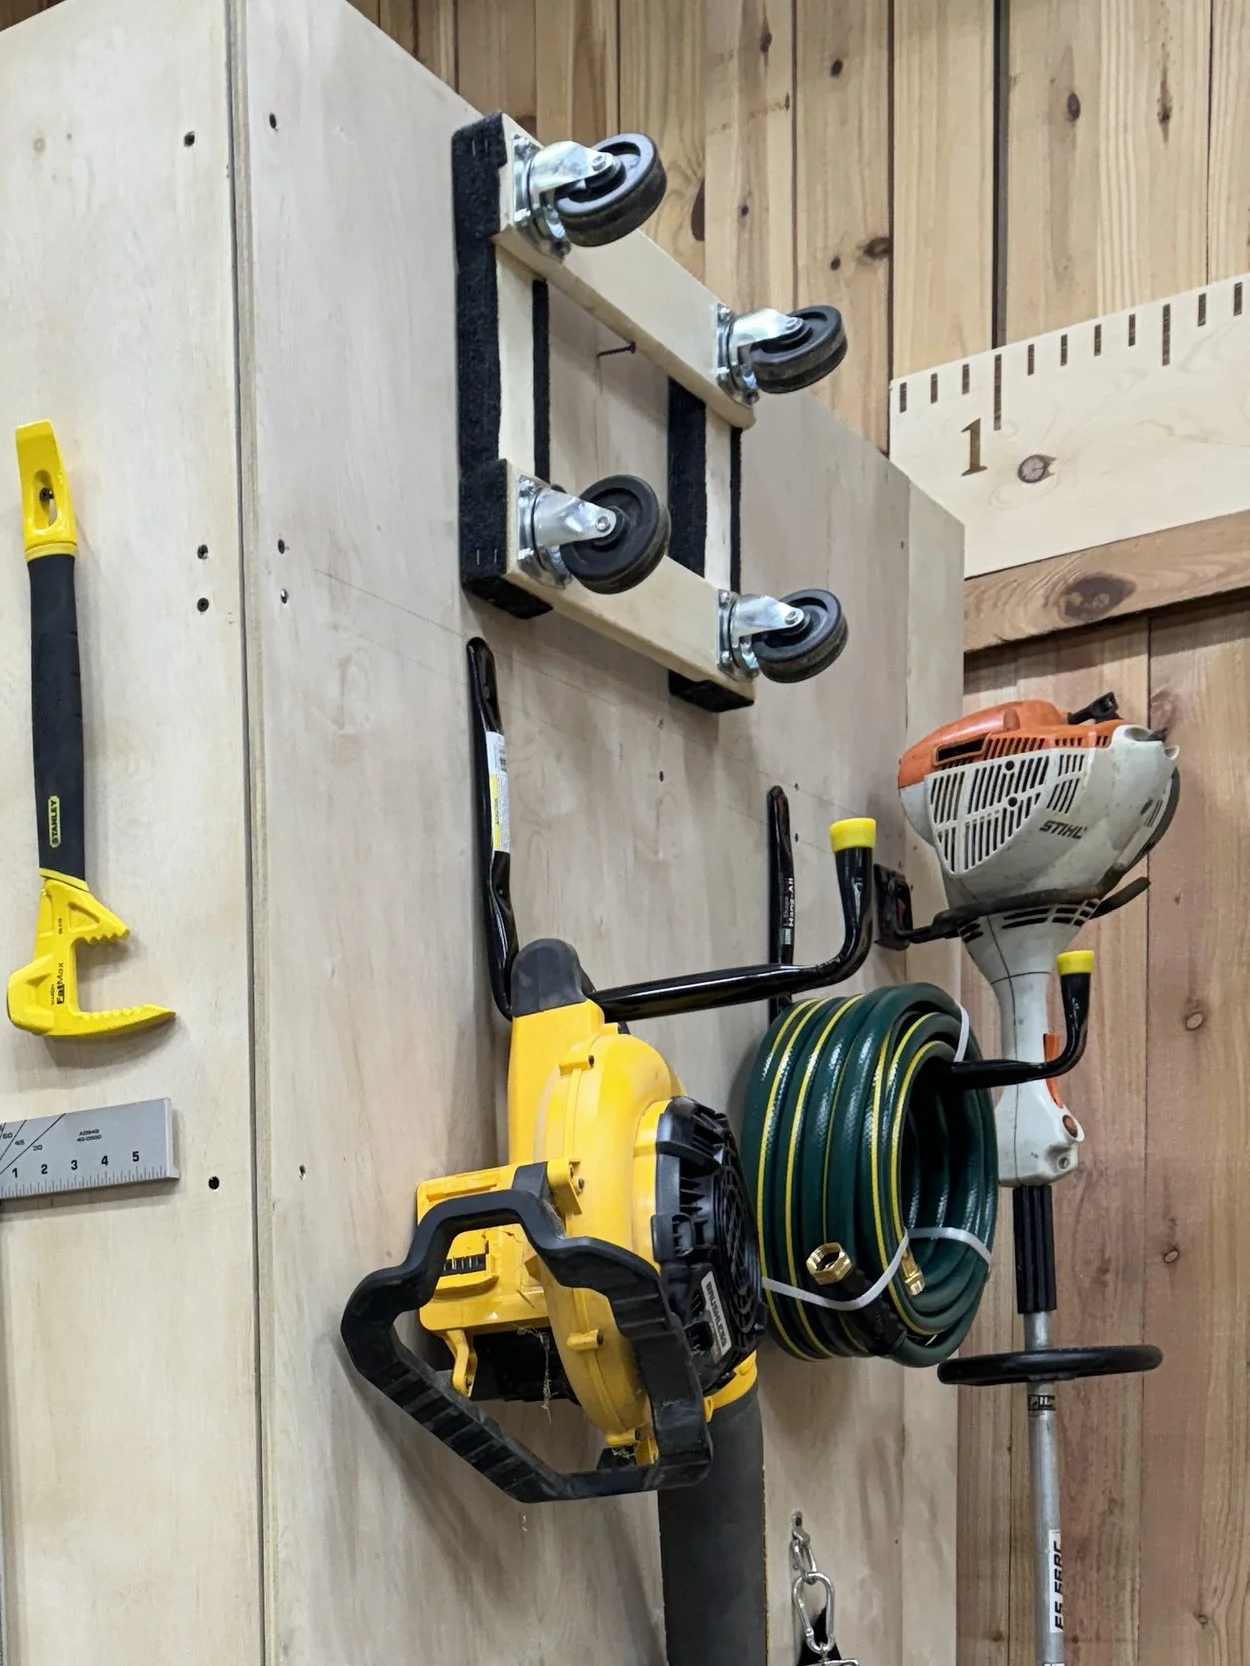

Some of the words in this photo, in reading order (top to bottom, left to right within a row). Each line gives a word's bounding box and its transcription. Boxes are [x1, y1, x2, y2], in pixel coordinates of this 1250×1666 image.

[961, 418, 988, 477] 1
[50, 798, 61, 847] STANLEY
[1039, 820, 1082, 840] STIHL
[56, 962, 65, 1005] FatMax
[11, 1167, 19, 1180] 1
[40, 1163, 49, 1176] 2
[70, 1159, 79, 1172] 3
[100, 1154, 110, 1167] 4
[132, 1150, 141, 1163] 5
